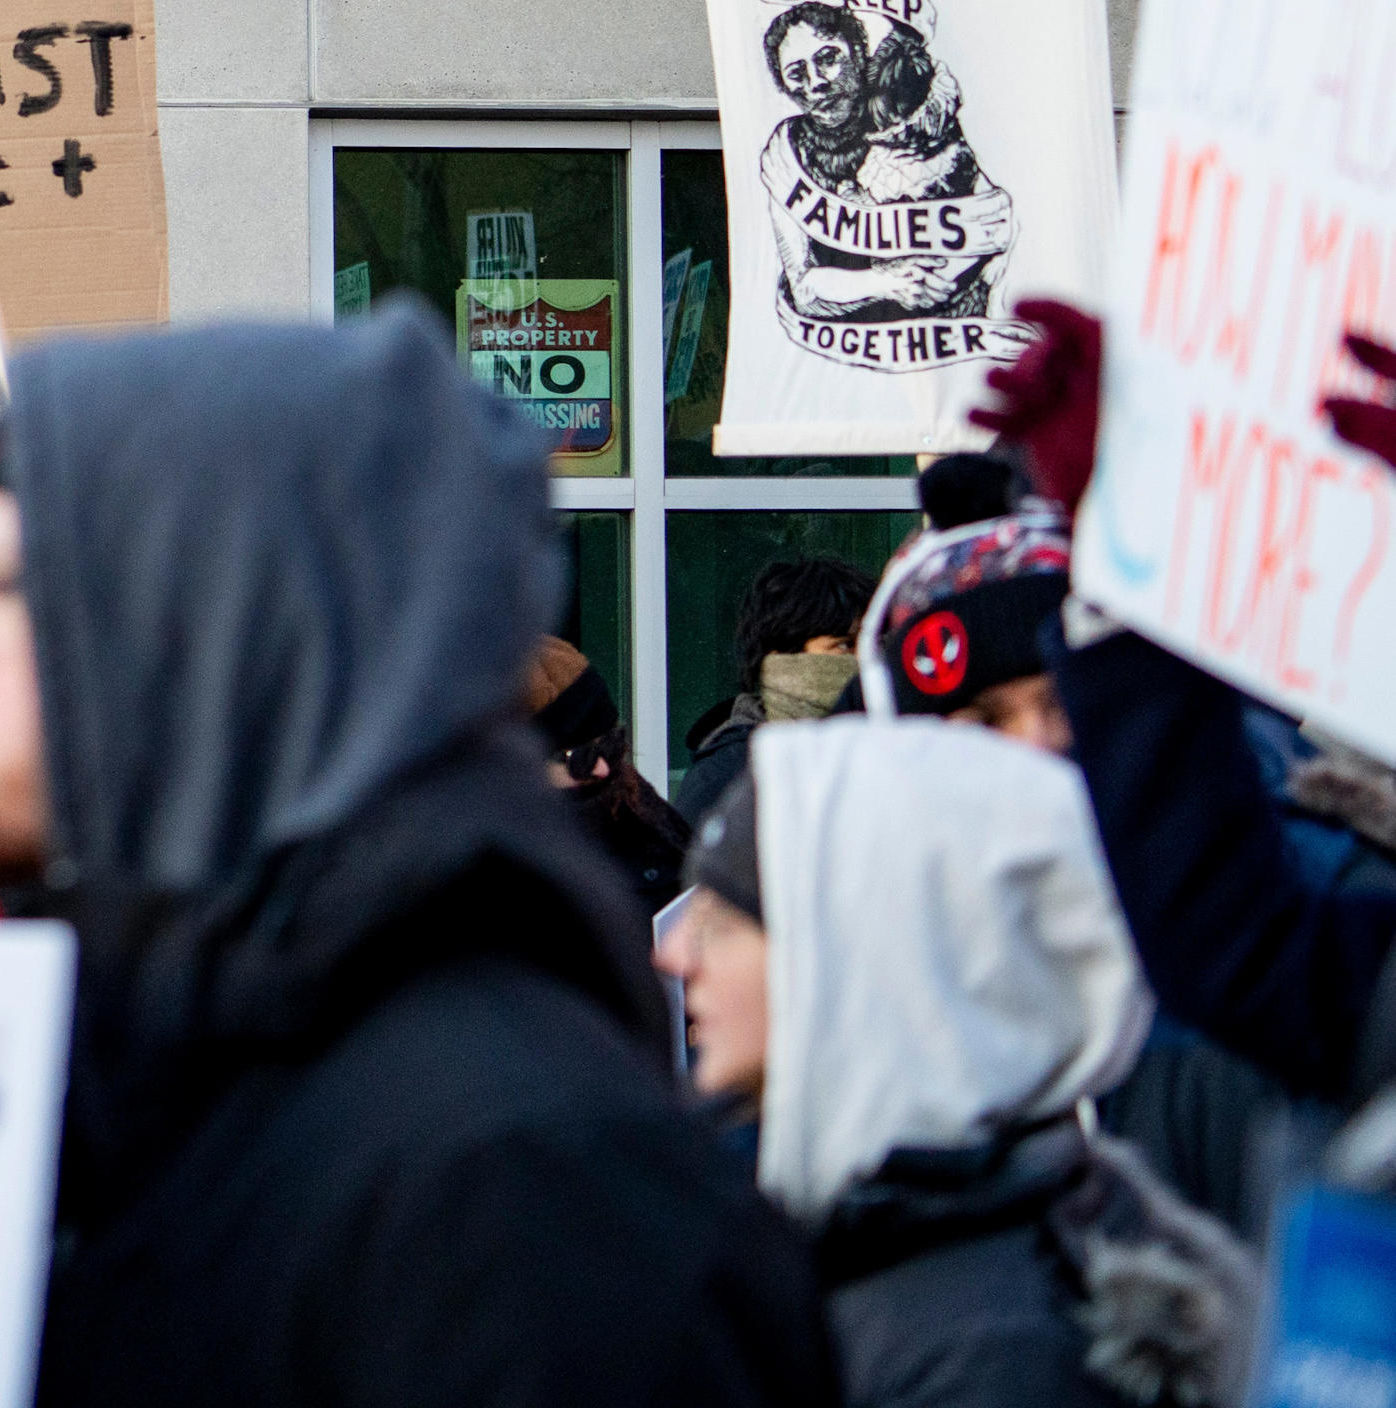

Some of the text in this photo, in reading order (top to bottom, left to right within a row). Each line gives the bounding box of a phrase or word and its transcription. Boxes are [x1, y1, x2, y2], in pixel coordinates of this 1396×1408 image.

[785, 178, 968, 251] FAMILIES
[521, 311, 564, 329] U.S.
[481, 329, 599, 347] PROPERTY
[798, 320, 988, 363] TOGETHER
[493, 354, 586, 396] NO
[523, 403, 600, 430] PASSING
